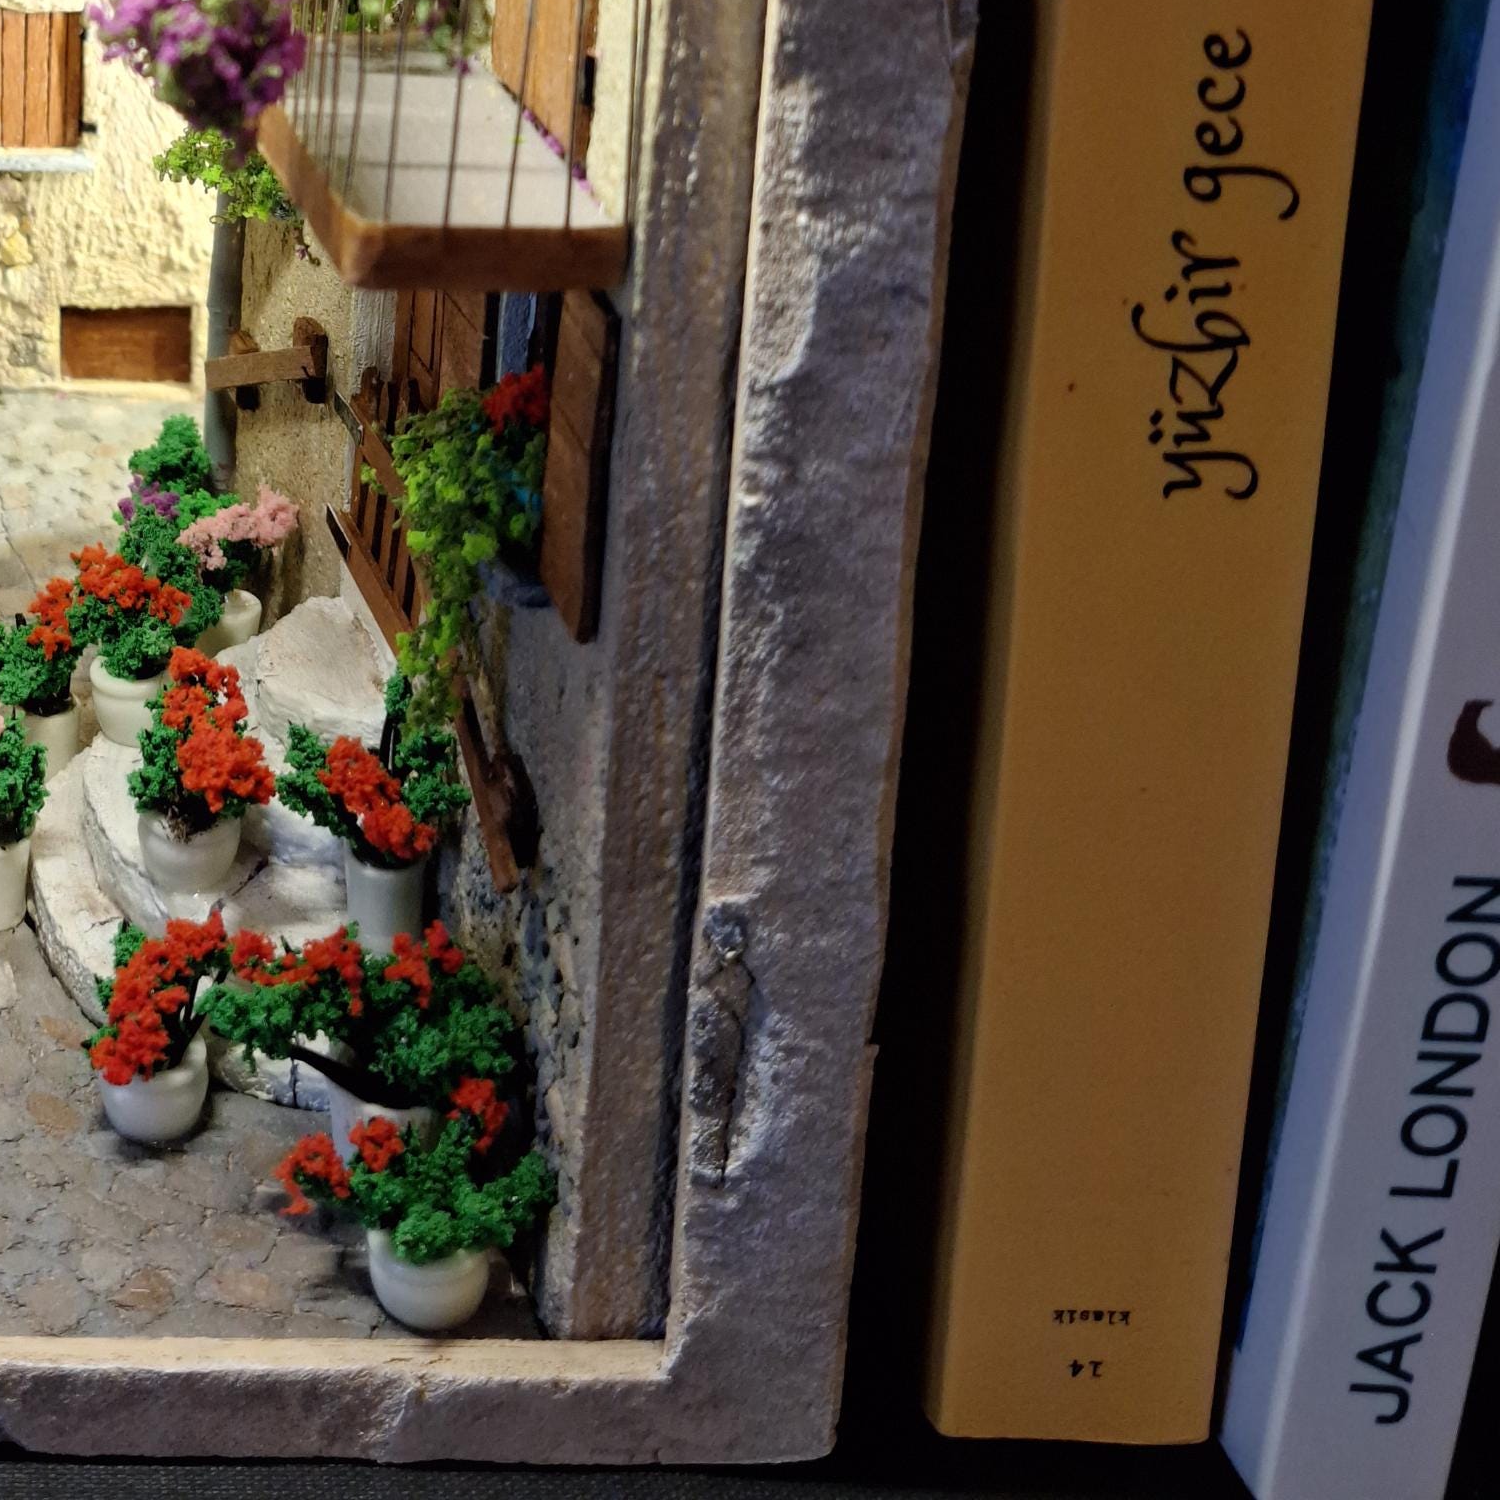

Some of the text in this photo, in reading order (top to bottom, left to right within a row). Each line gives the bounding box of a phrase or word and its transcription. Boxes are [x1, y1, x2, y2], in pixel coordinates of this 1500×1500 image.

[1183, 27, 1300, 221] gece
[1131, 229, 1259, 500] yüzbir
[1348, 875, 1500, 1426] JACK LONDON
[1052, 1309, 1132, 1327] klasik
[1067, 1359, 1104, 1378] 14
